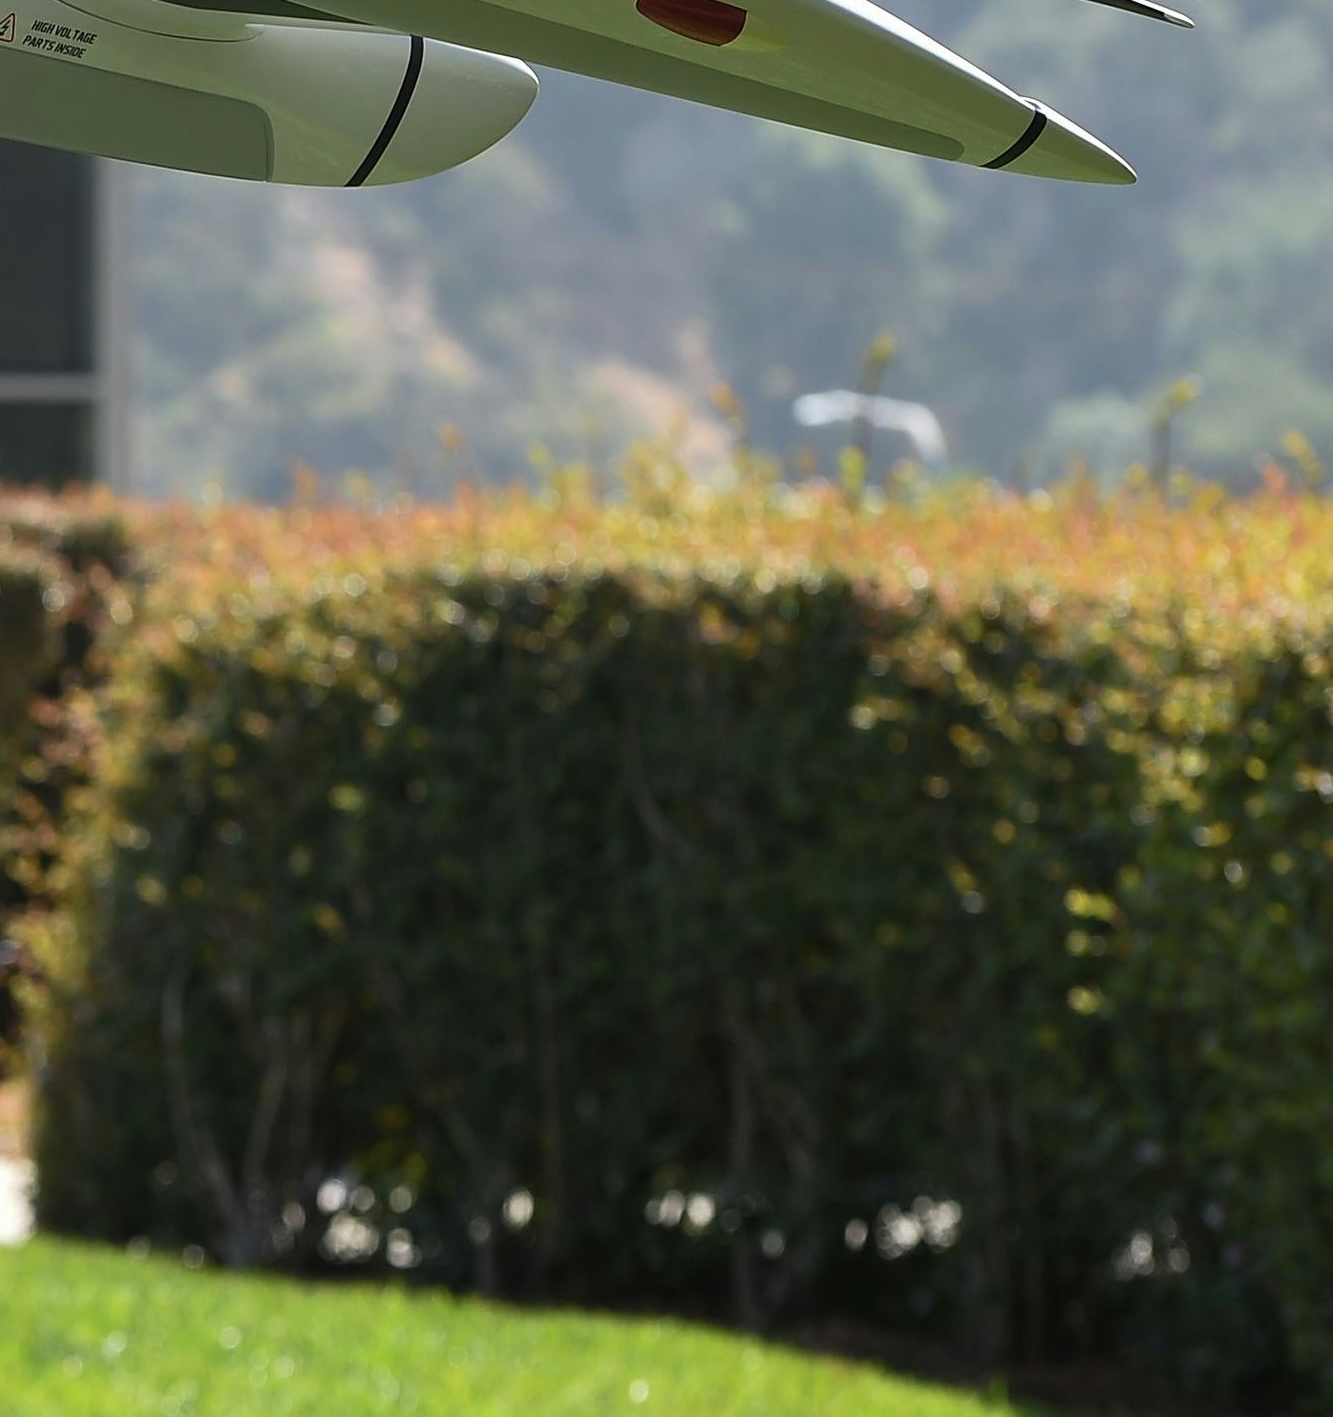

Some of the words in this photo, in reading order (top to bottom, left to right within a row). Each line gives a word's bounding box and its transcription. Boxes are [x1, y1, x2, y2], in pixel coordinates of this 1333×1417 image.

[31, 20, 55, 35] HIGH
[55, 24, 98, 45] VOLTAGE
[23, 35, 55, 51] PARTS
[54, 43, 87, 59] INSIDE
